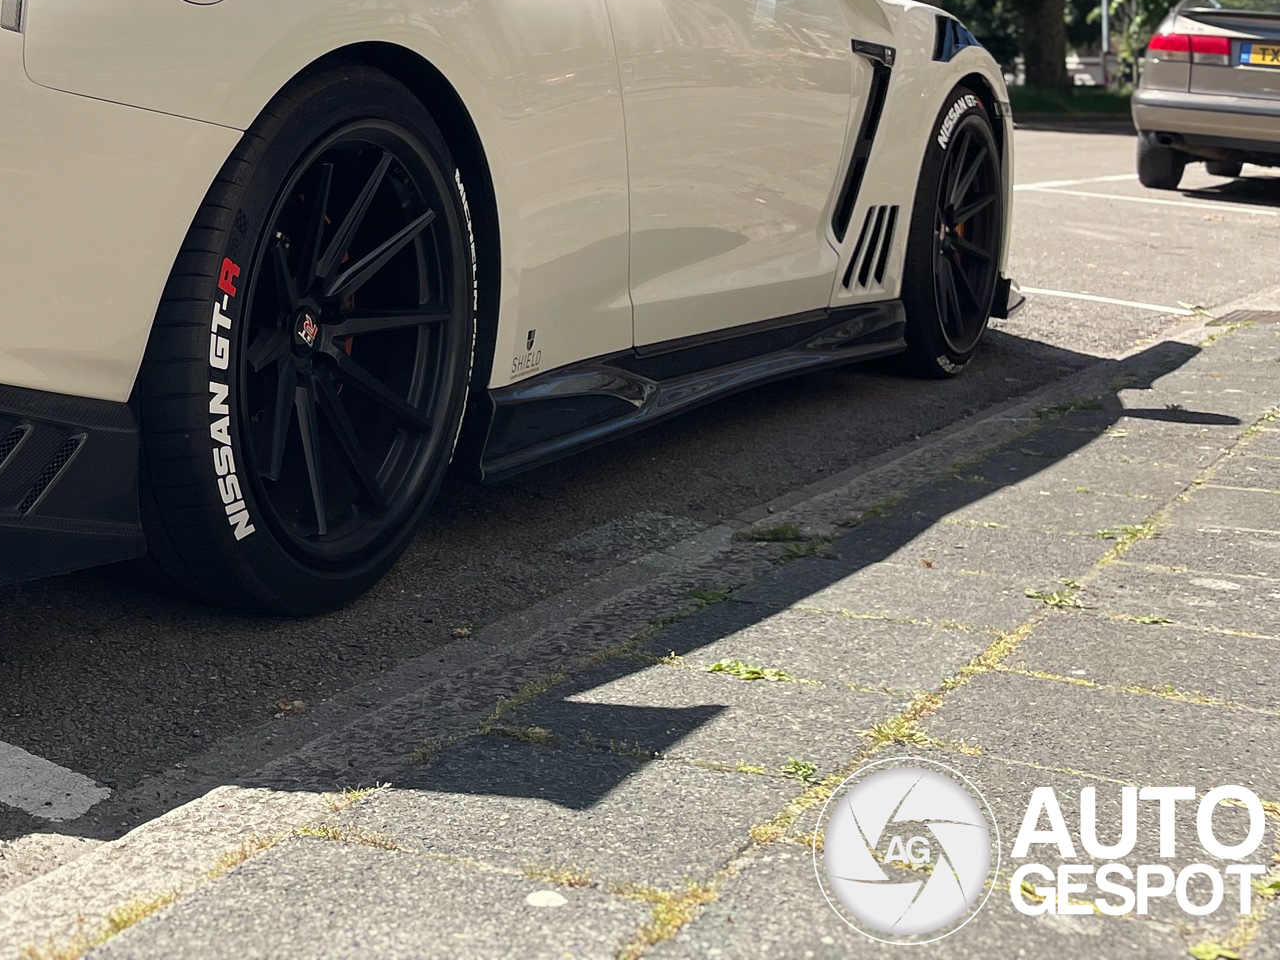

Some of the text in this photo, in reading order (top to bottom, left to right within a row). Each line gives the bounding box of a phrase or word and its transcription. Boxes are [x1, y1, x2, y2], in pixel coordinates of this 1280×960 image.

[1259, 47, 1280, 63] TX
[937, 96, 968, 150] NISSAN
[511, 350, 542, 374] SHIELD
[209, 256, 256, 541] NISSAN GT-R
